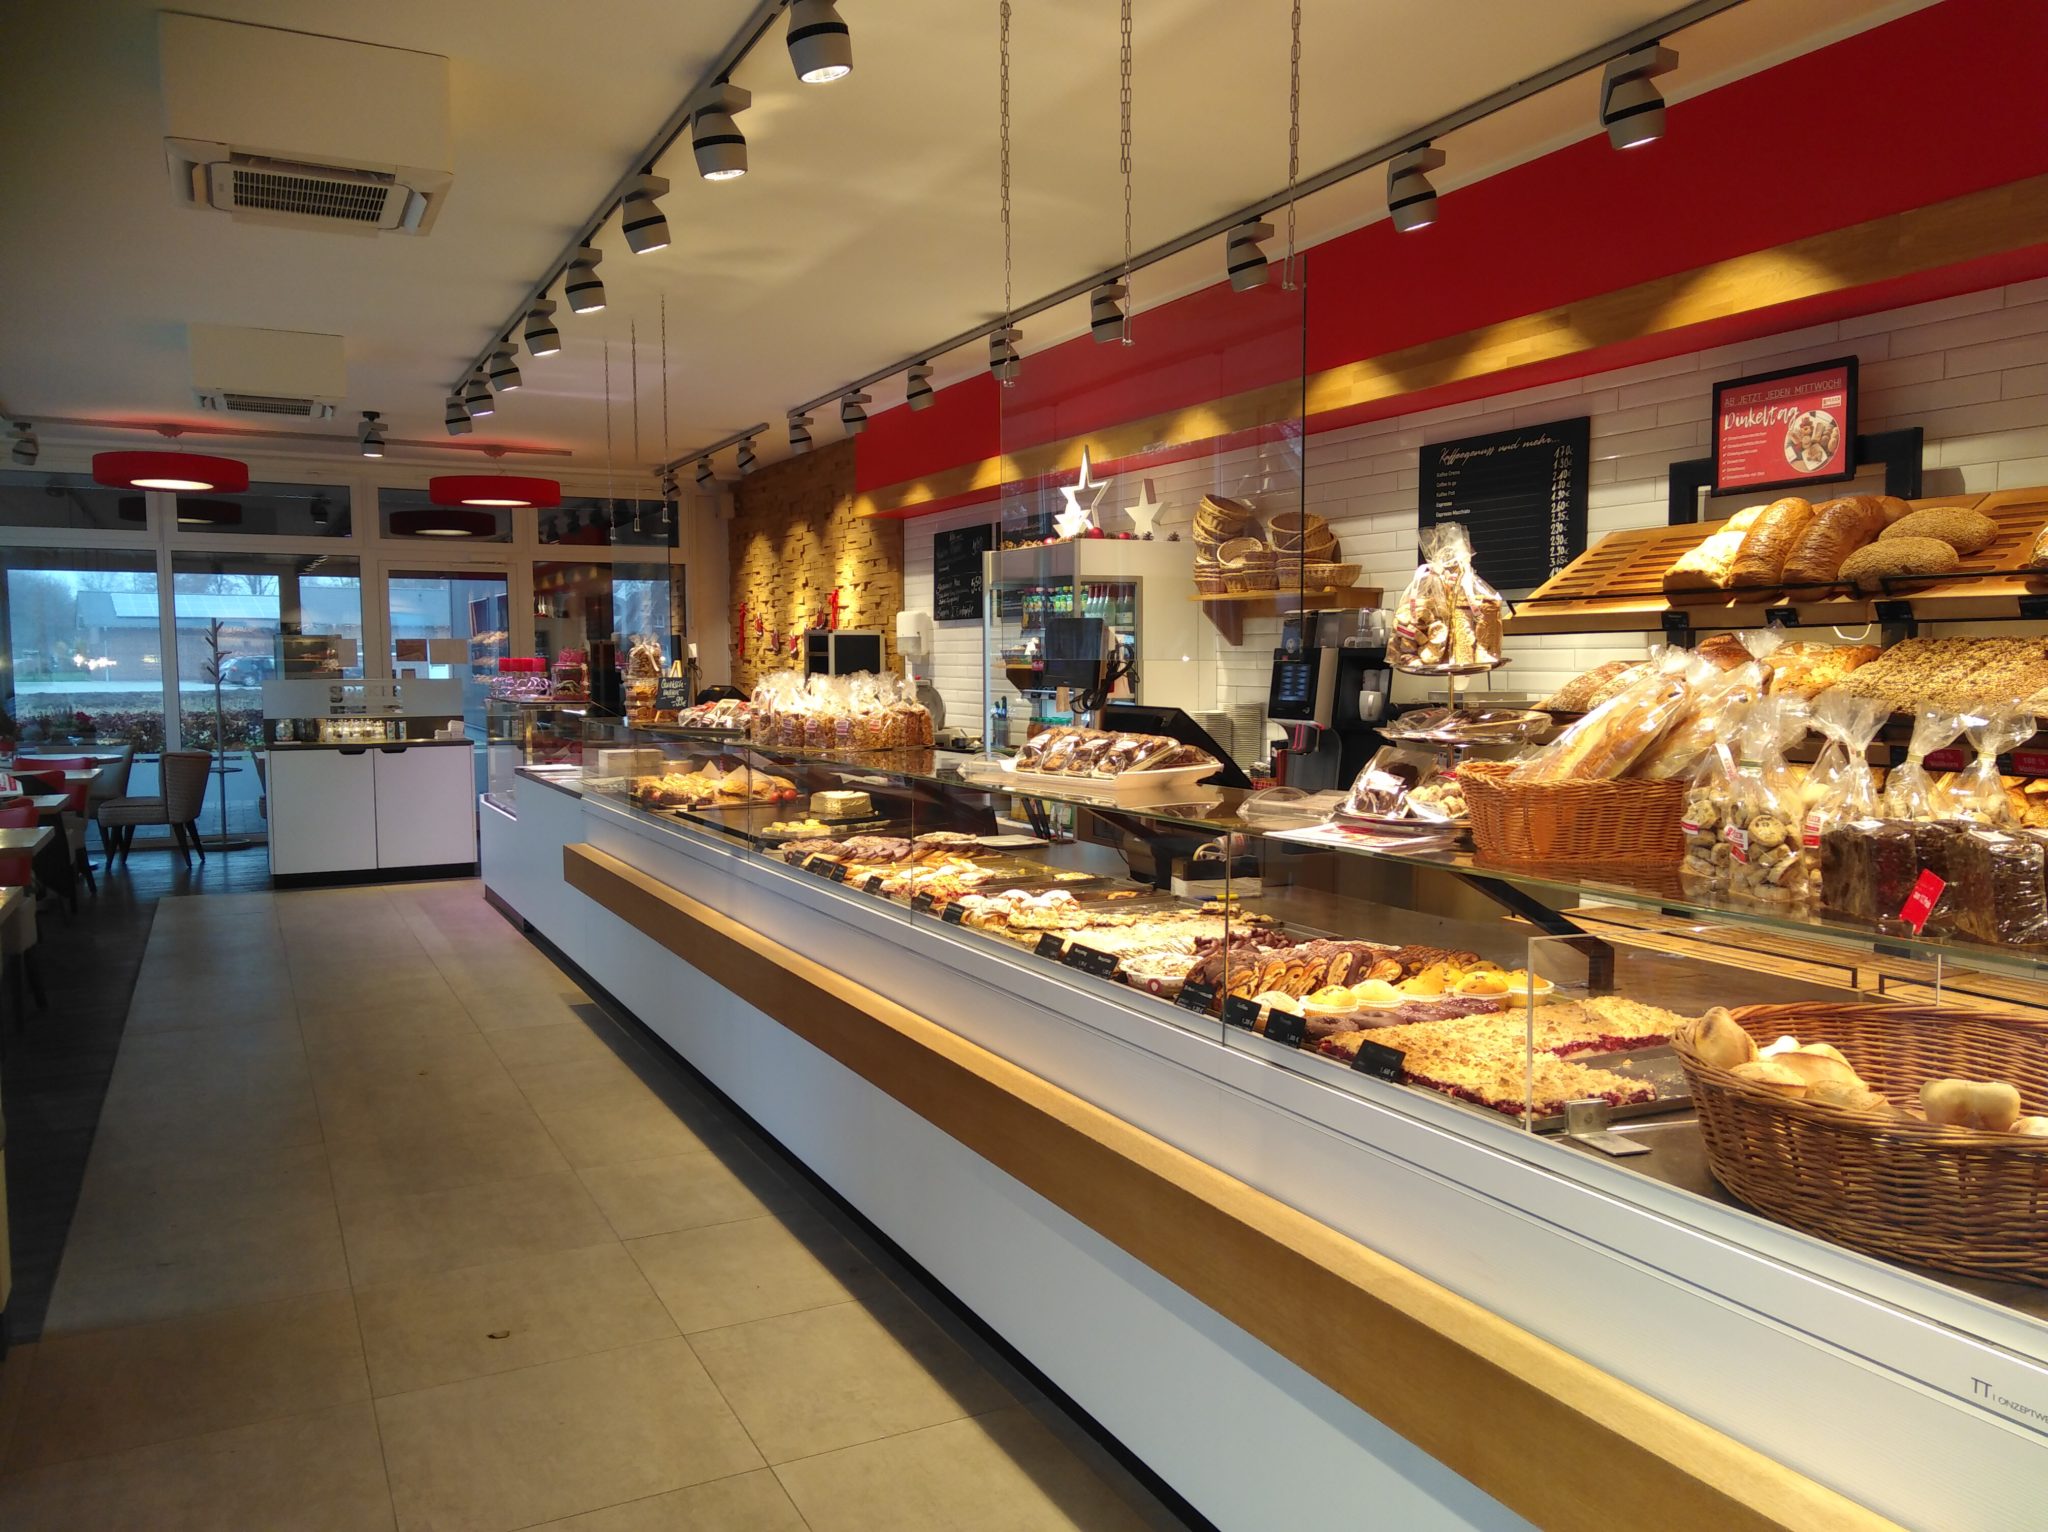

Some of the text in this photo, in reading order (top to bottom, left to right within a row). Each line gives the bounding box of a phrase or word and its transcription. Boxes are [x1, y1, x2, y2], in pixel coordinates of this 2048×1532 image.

[1725, 378, 1842, 407] AB JETZT JEDEN MITTWOCH!
[1725, 405, 1800, 430] Dinkeltag
[1498, 437, 1521, 451] und
